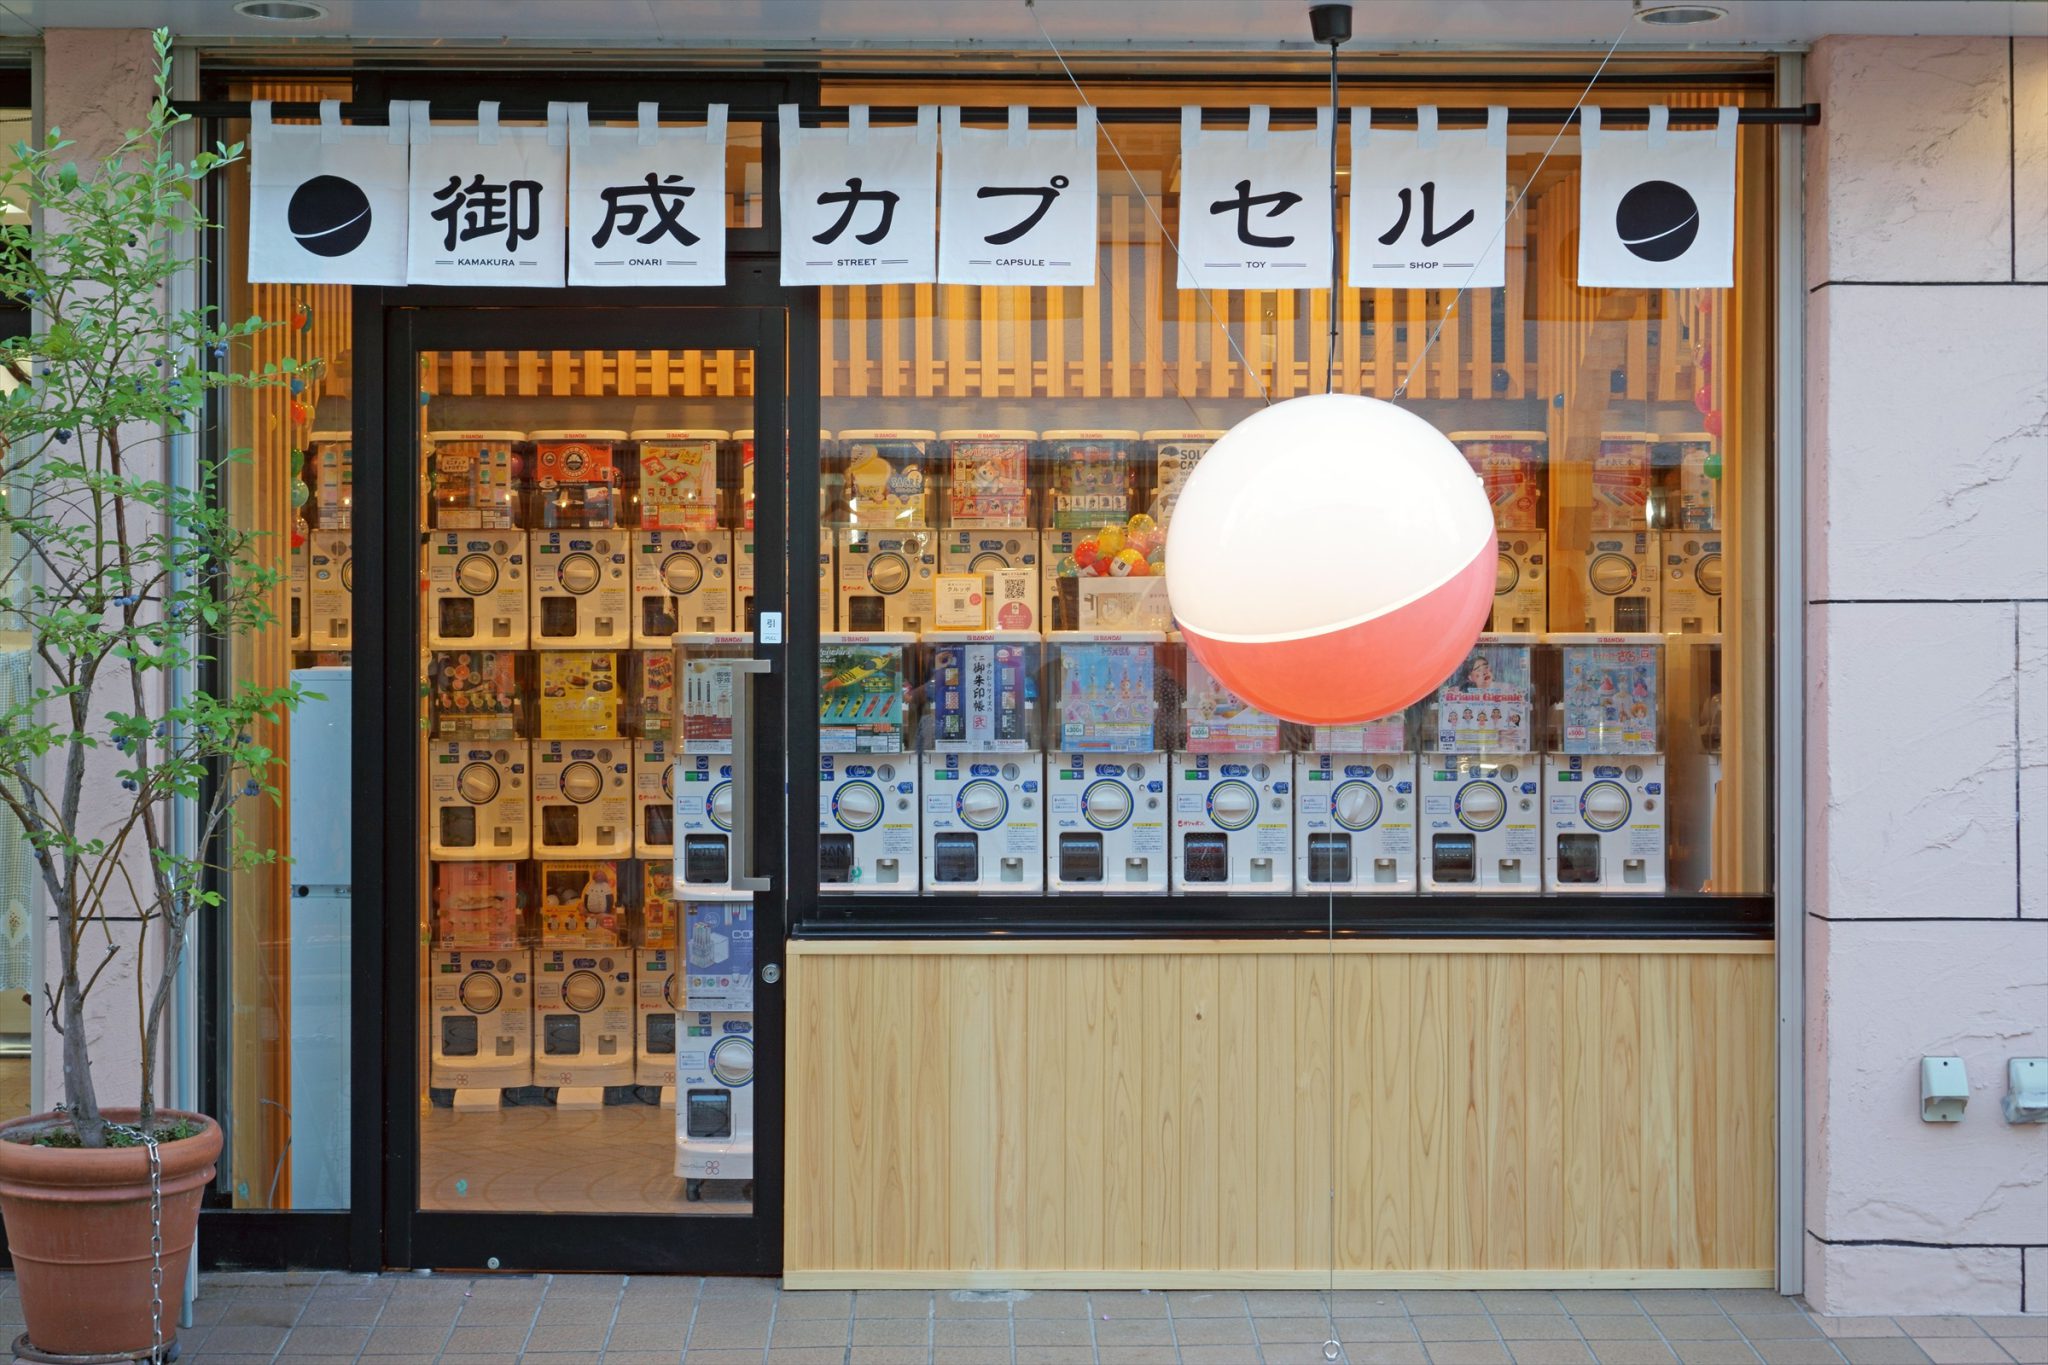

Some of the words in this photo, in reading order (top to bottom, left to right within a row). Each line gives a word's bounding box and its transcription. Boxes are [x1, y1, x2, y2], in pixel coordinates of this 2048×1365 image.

[457, 258, 516, 267] KAMAKURA
[628, 258, 663, 267] ONARI
[836, 257, 877, 267] STREET
[995, 258, 1046, 267] CAPSULE
[1246, 260, 1267, 269] TOY
[1409, 261, 1440, 269] SHOP
[1180, 449, 1208, 461] SOL
[973, 662, 985, 712] 御朱印帳
